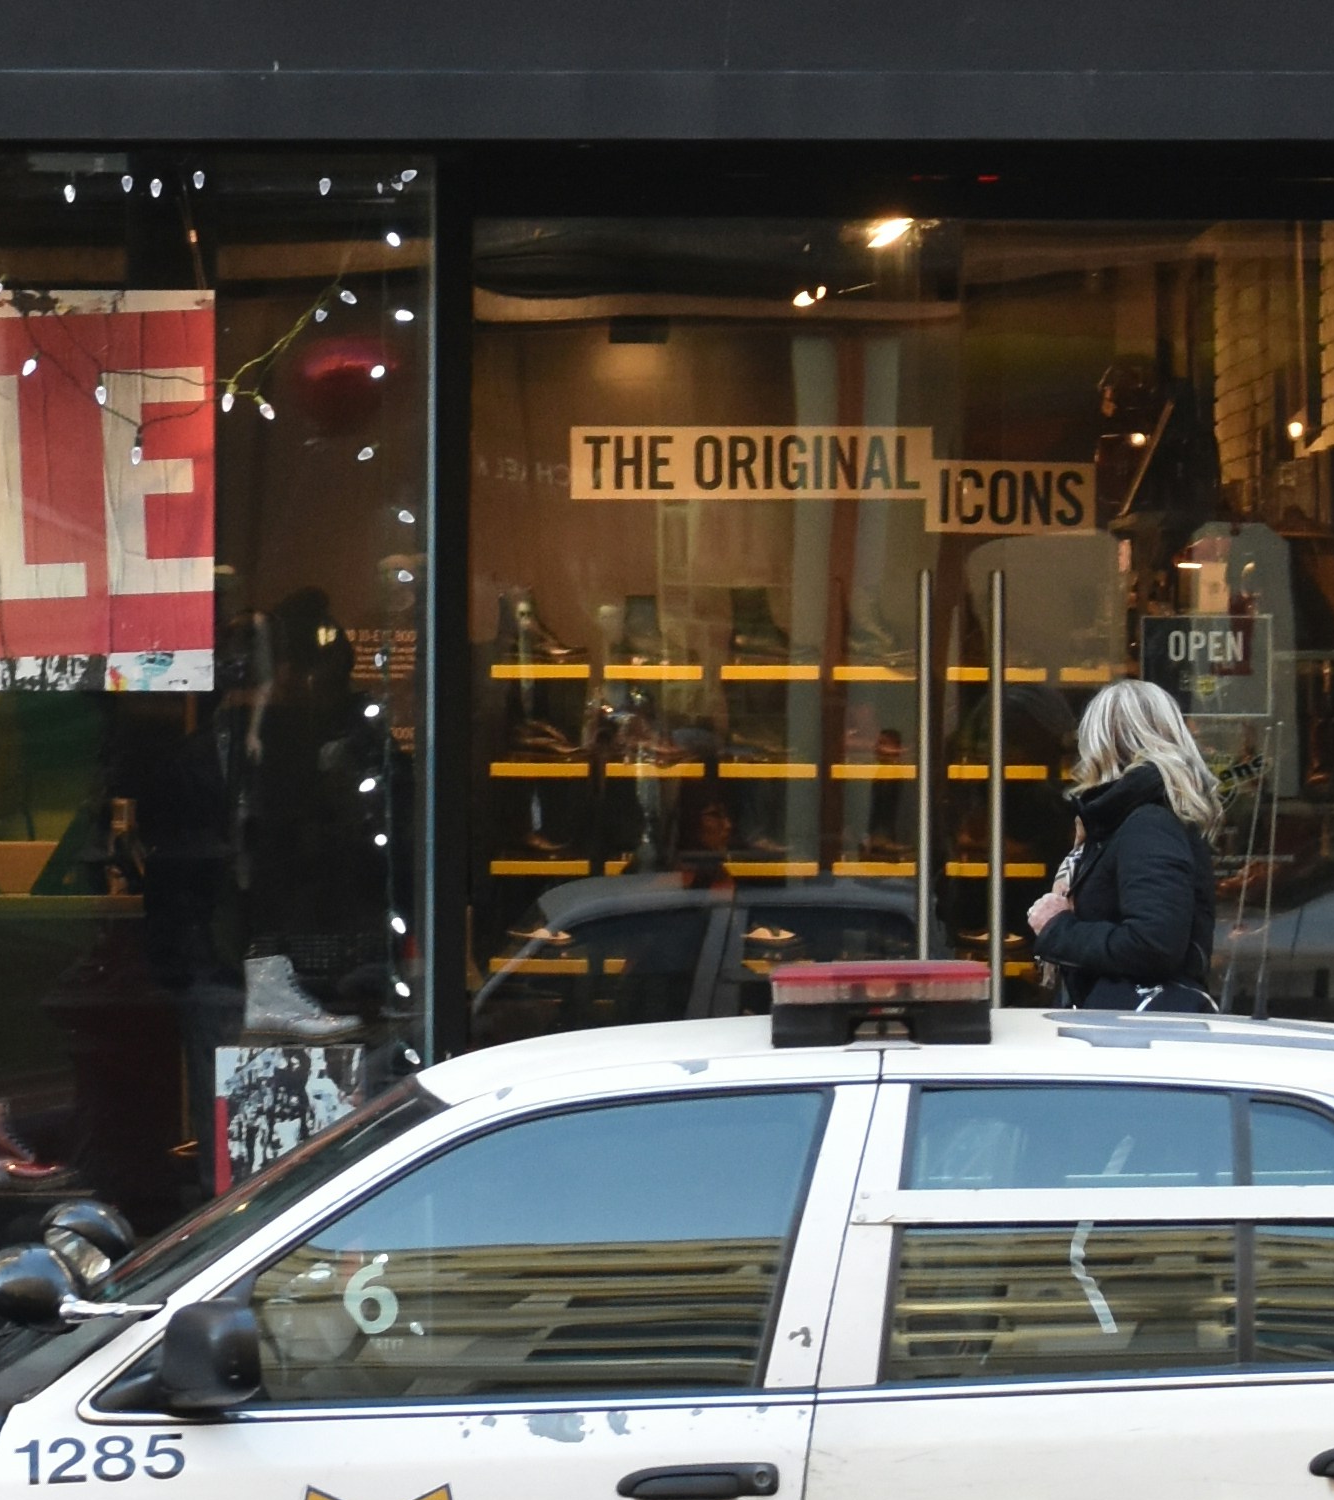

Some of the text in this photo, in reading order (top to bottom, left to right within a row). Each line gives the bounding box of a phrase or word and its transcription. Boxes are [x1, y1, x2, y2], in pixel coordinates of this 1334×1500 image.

[584, 435, 674, 490] THE
[693, 435, 920, 491] ORIGINAL
[939, 468, 1084, 525] ICONS
[1168, 629, 1244, 663] OPEN
[14, 1433, 186, 1486] 1285
